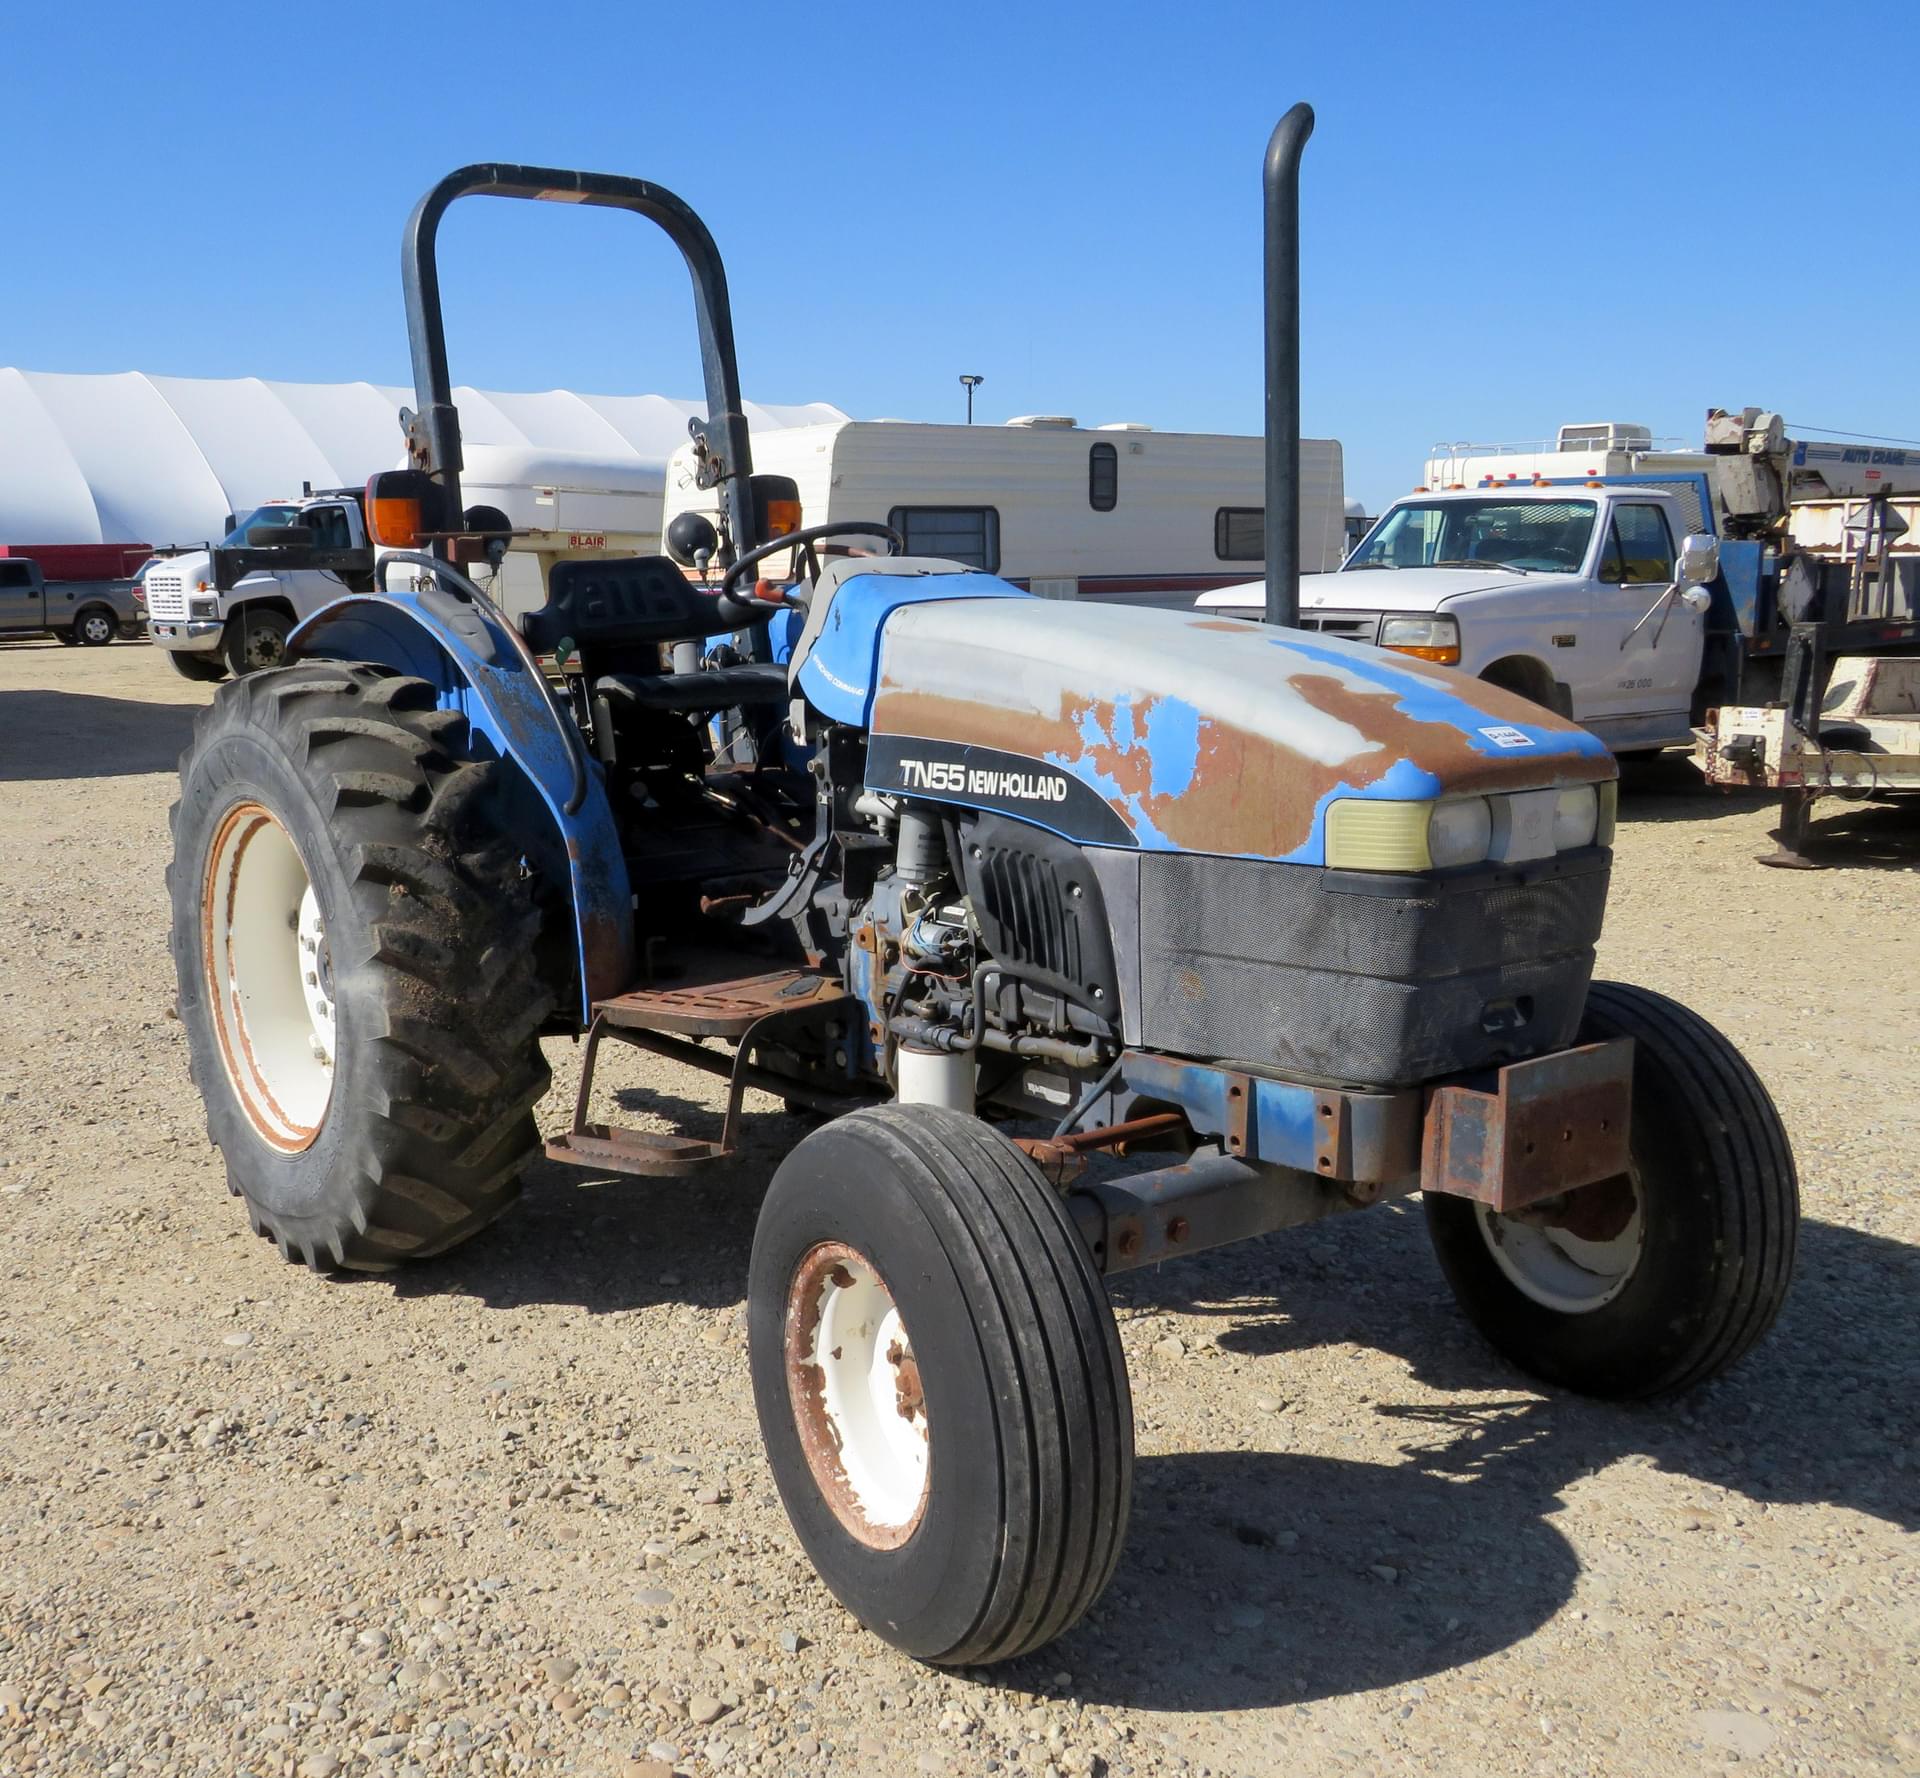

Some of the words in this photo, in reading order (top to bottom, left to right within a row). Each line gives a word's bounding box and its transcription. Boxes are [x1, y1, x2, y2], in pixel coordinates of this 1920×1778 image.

[570, 536, 604, 546] BLAIR
[900, 759, 966, 792] TN55
[968, 769, 999, 796] NEW
[999, 772, 1068, 802] HOLLAND
